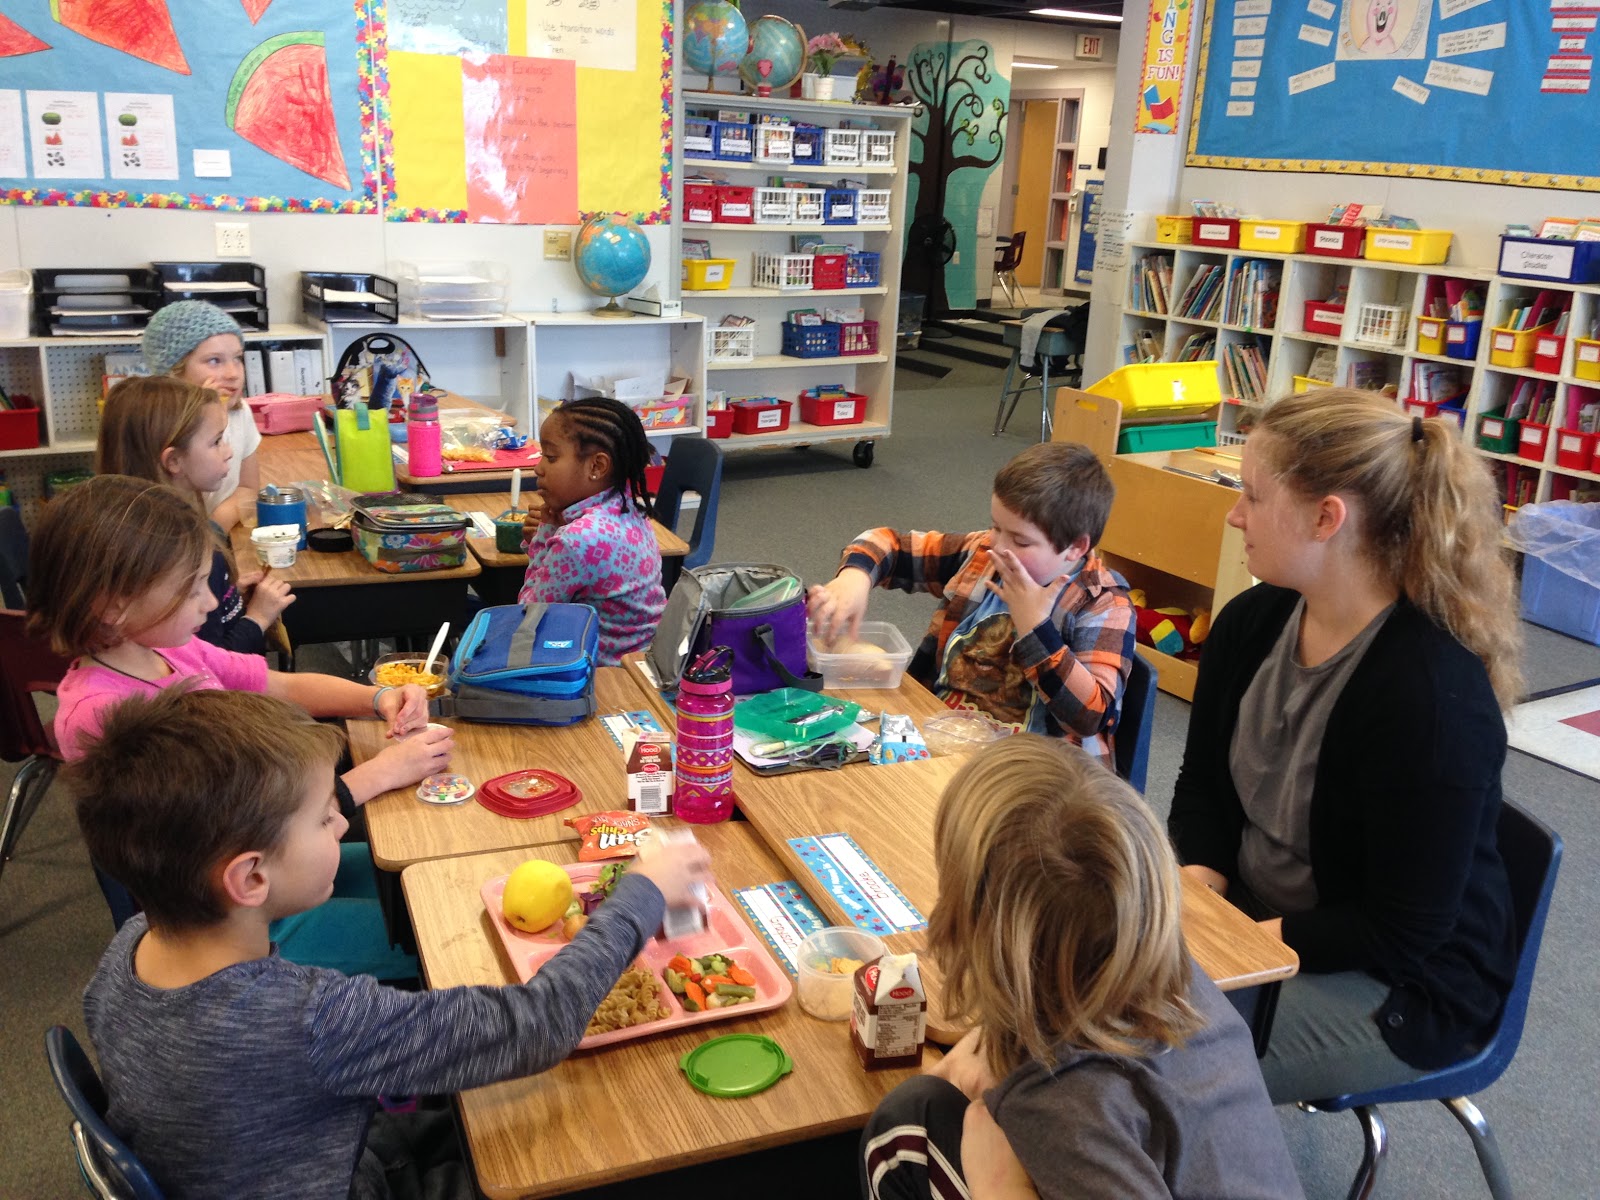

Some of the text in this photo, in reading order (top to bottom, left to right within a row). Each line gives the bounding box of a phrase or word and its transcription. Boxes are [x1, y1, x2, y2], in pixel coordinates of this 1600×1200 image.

[1083, 36, 1100, 55] EXIT
[1158, 49, 1174, 62] IS
[1147, 66, 1180, 79] FUN!
[1521, 250, 1554, 261] Character
[599, 828, 653, 850] Sun
[860, 871, 889, 900] Brooke
[770, 916, 798, 948] Grayson
